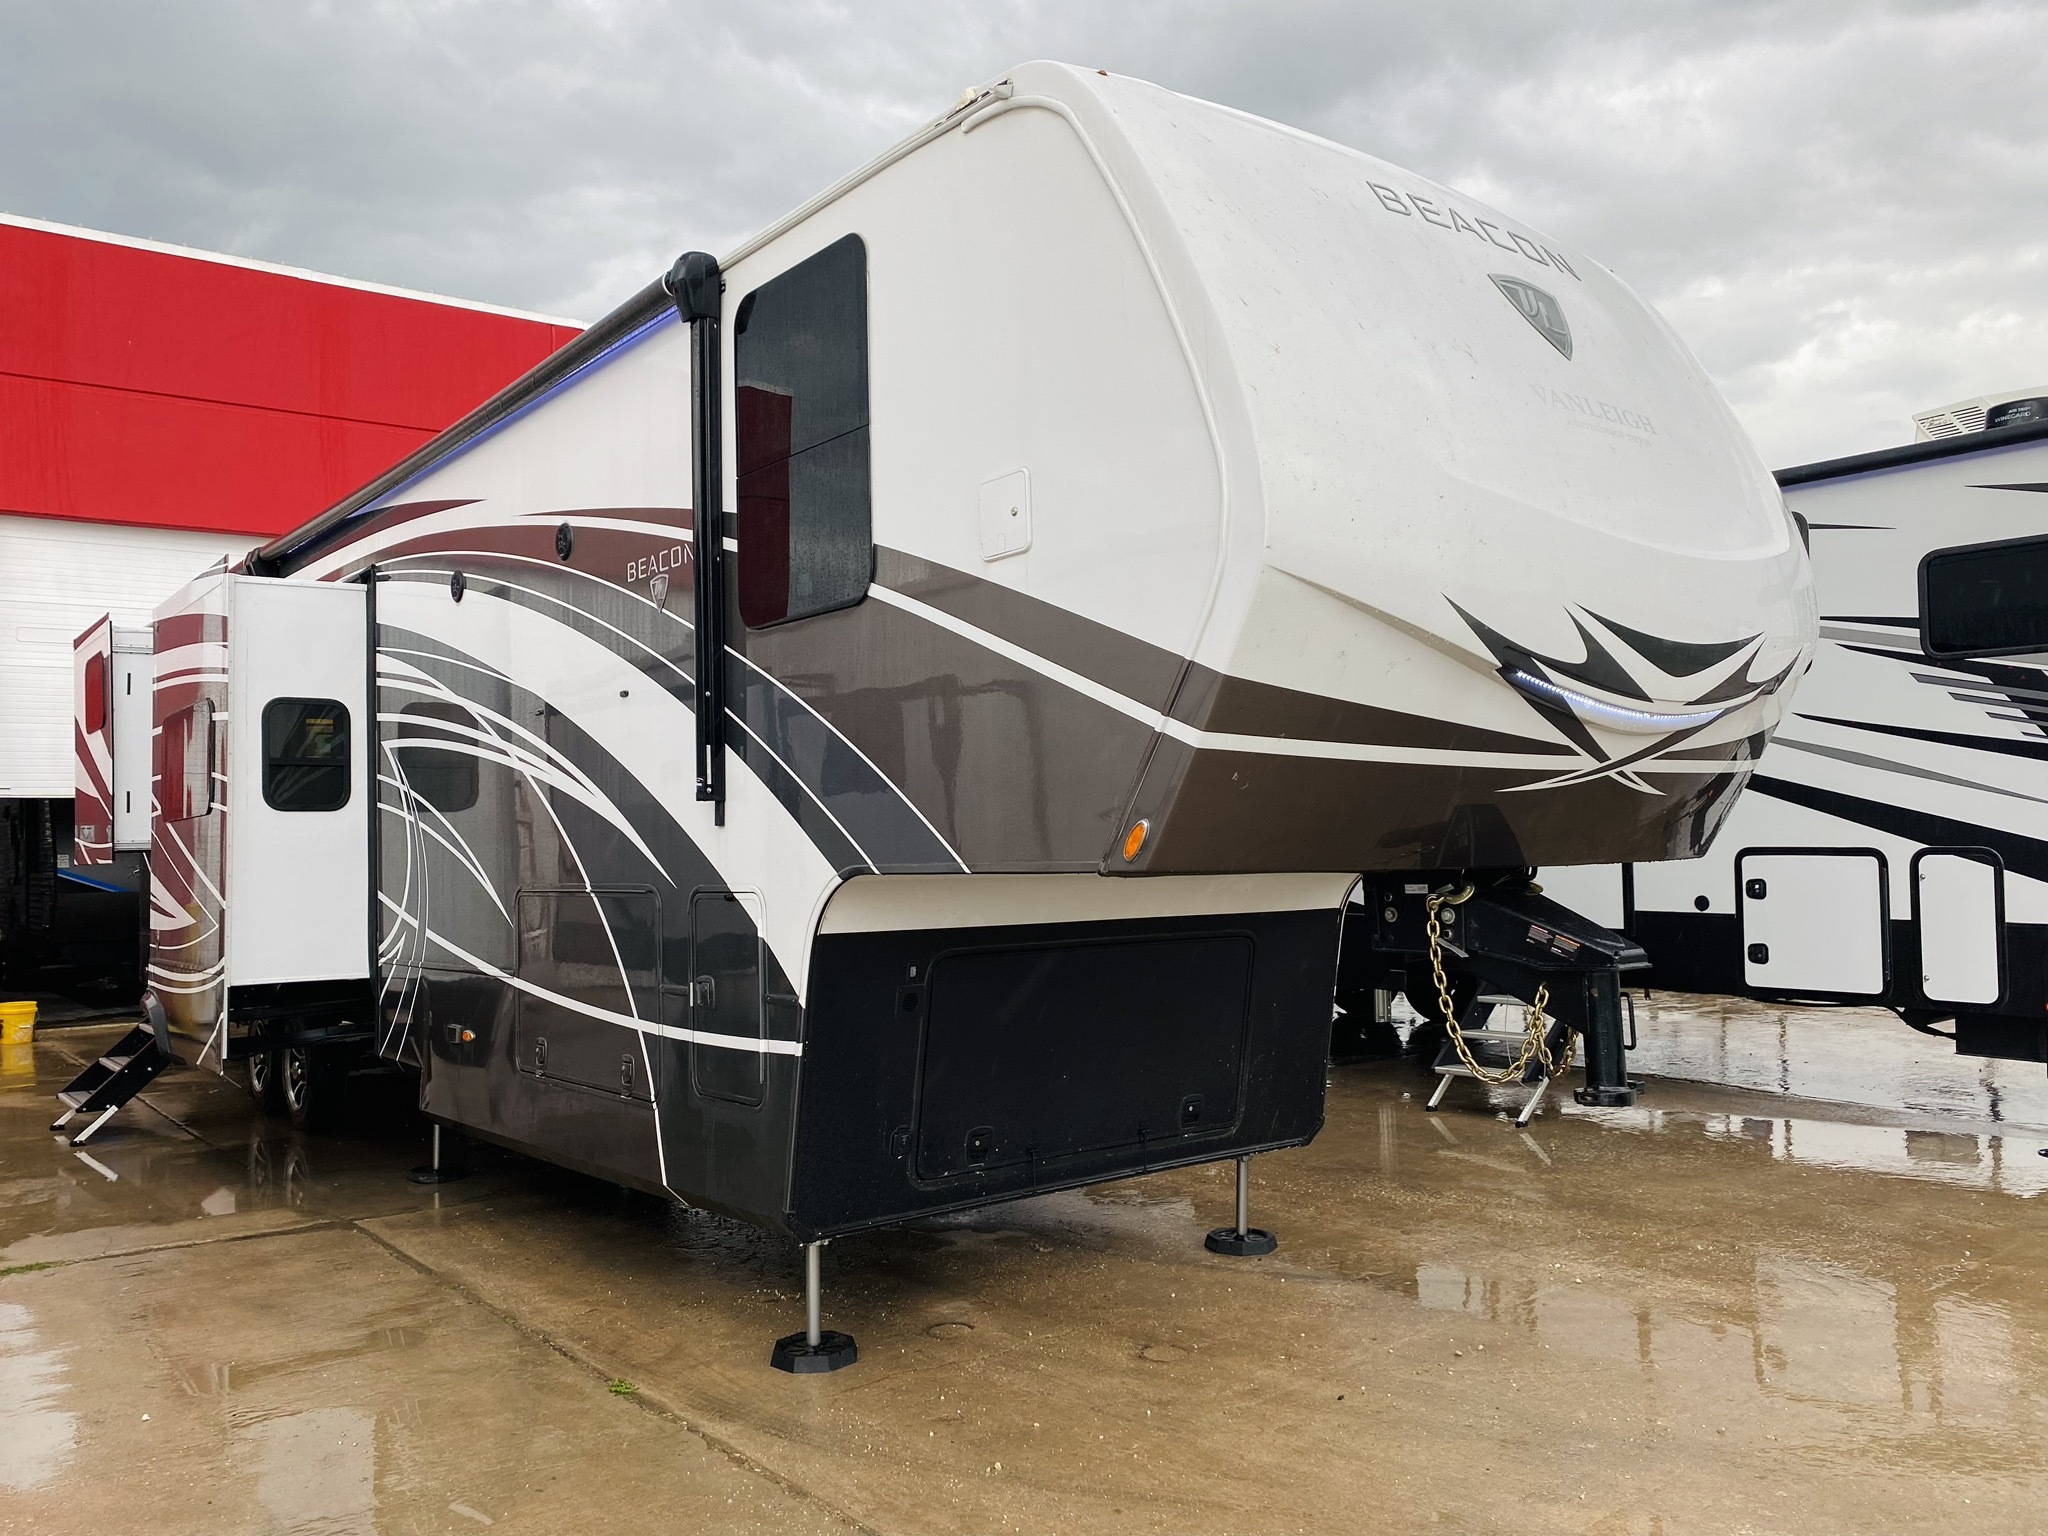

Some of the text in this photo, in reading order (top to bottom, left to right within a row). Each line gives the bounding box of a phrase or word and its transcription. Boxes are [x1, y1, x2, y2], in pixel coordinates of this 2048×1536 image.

[1366, 180, 1582, 281] BEACON
[1528, 383, 1659, 436] VANLEIGH
[1994, 411, 2031, 423] WINEGARD
[627, 543, 694, 583] BEACON
